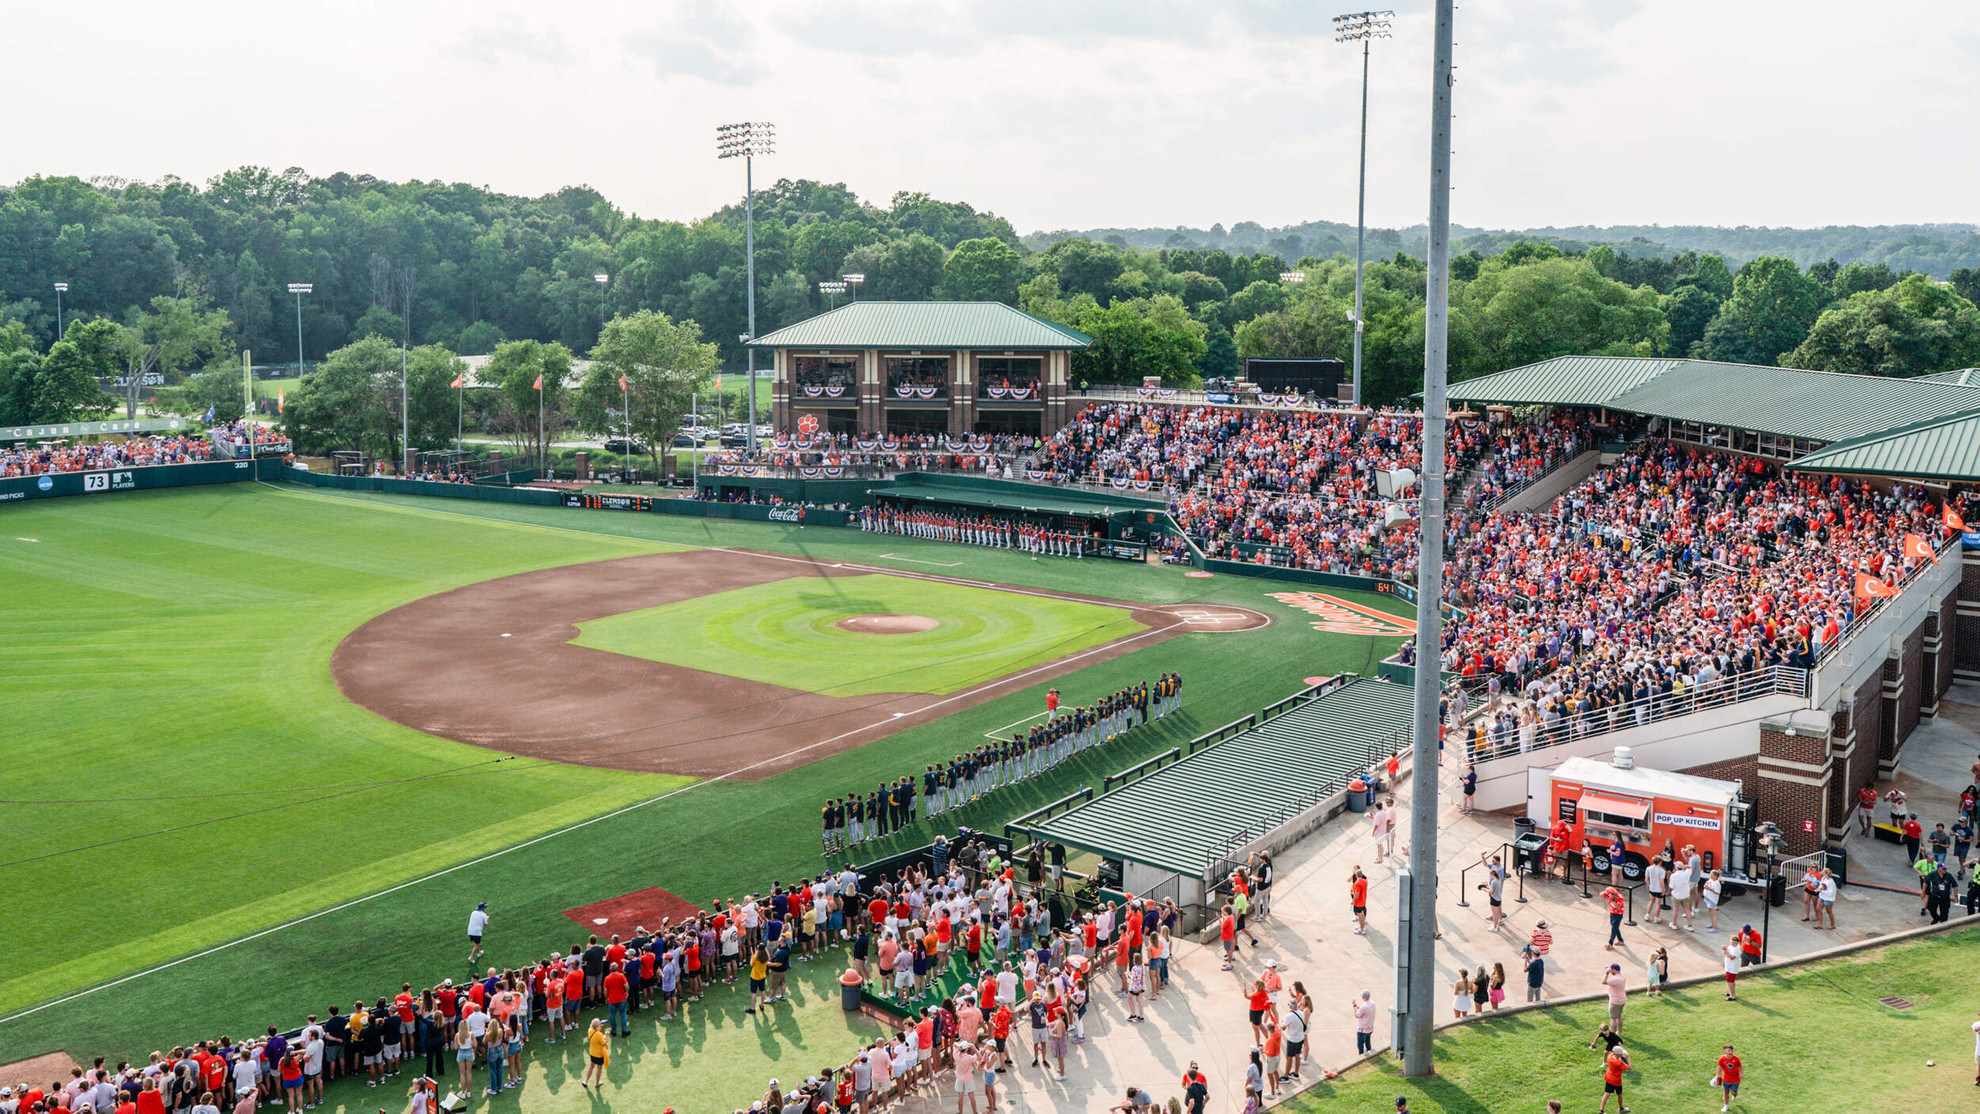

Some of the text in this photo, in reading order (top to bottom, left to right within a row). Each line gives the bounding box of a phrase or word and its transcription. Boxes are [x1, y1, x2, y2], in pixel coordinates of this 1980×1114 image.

[89, 477, 104, 489] 73
[602, 497, 631, 505] CLEMSON
[1947, 514, 1957, 525] C
[1917, 542, 1928, 554] C
[1378, 582, 1394, 593] 641
[1865, 580, 1877, 594] C
[1686, 819, 1718, 827] KITCHEN
